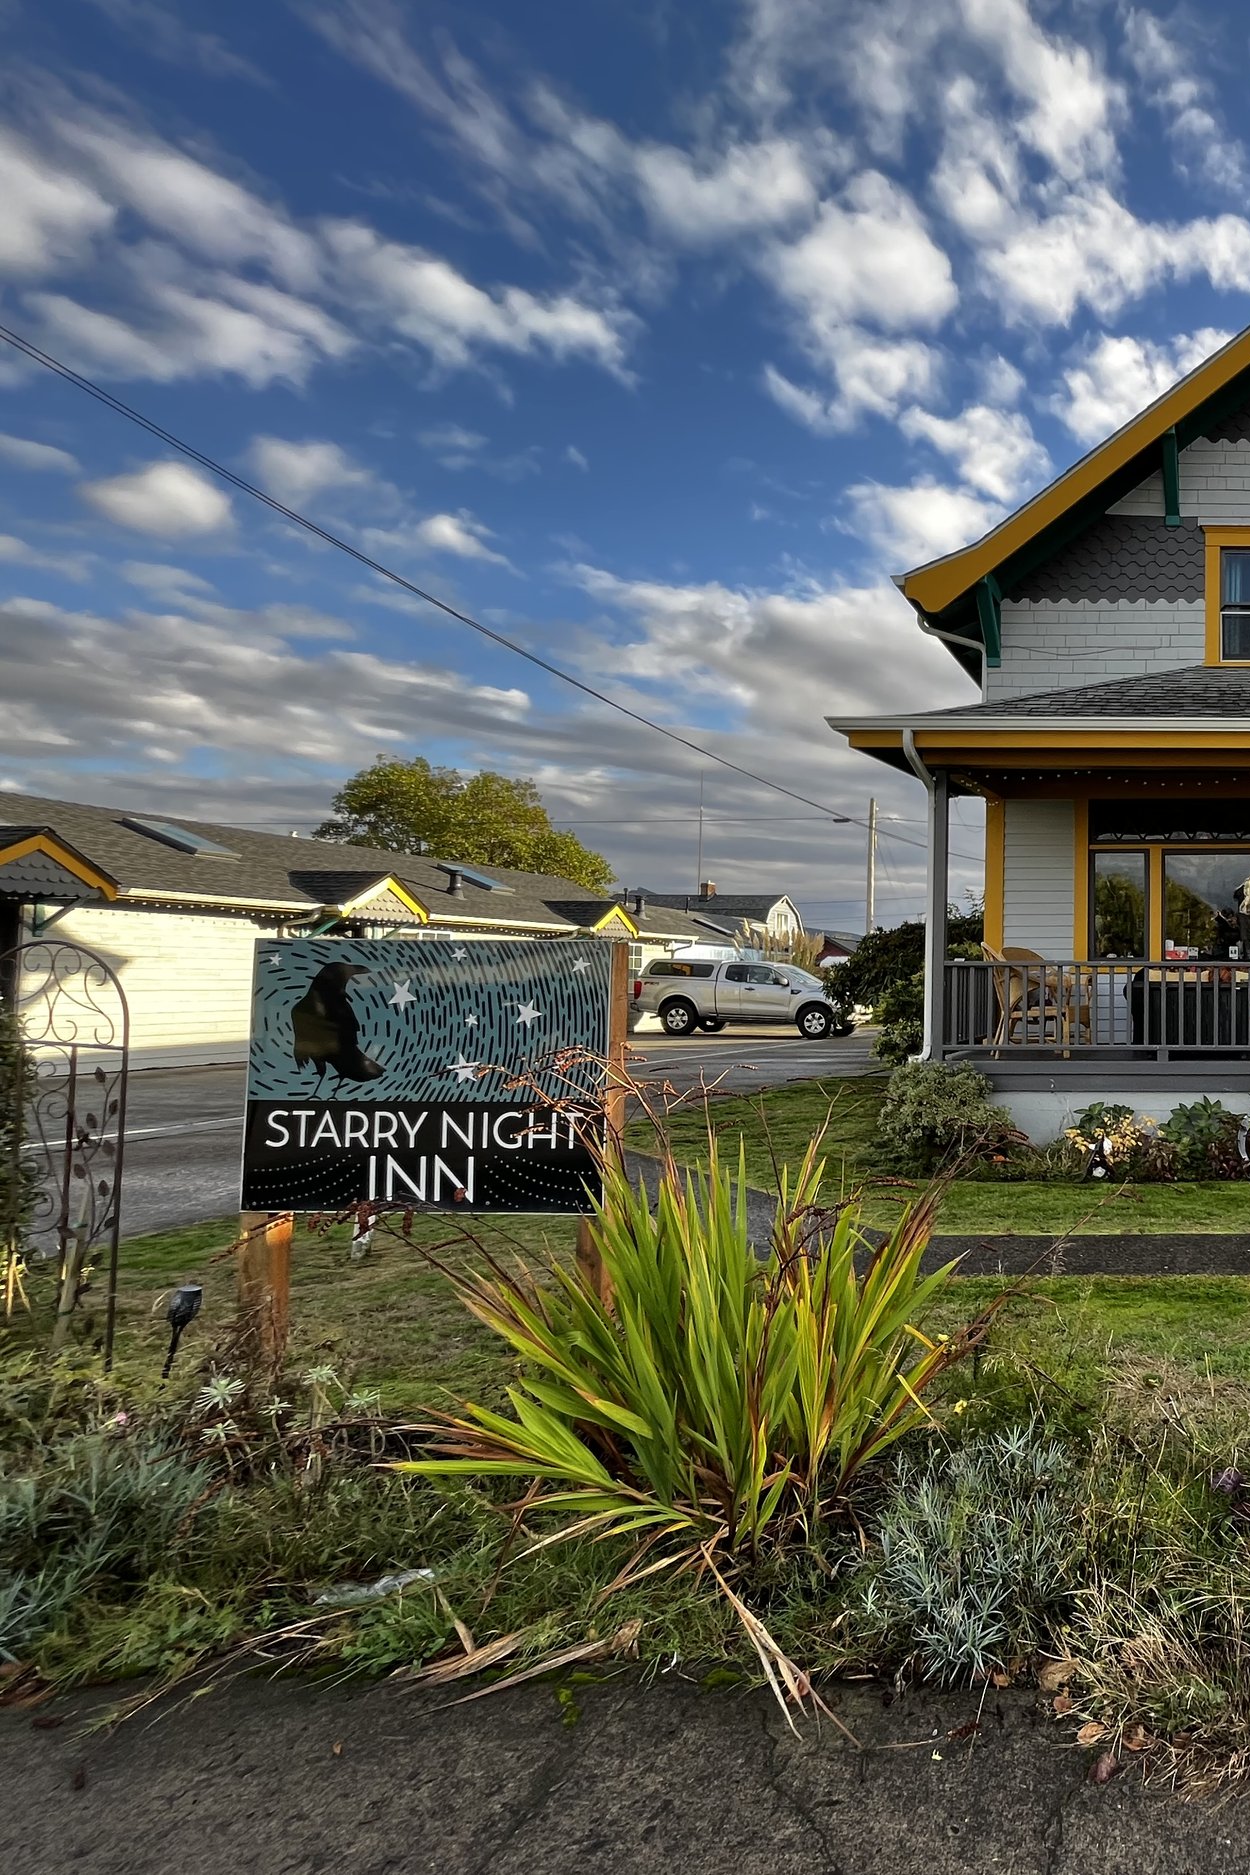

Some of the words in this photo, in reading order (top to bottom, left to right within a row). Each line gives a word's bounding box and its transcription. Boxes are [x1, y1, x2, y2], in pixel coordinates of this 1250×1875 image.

[265, 1110, 428, 1149] STARRY
[441, 1111, 585, 1150] NIGHT
[368, 1155, 474, 1204] INN
